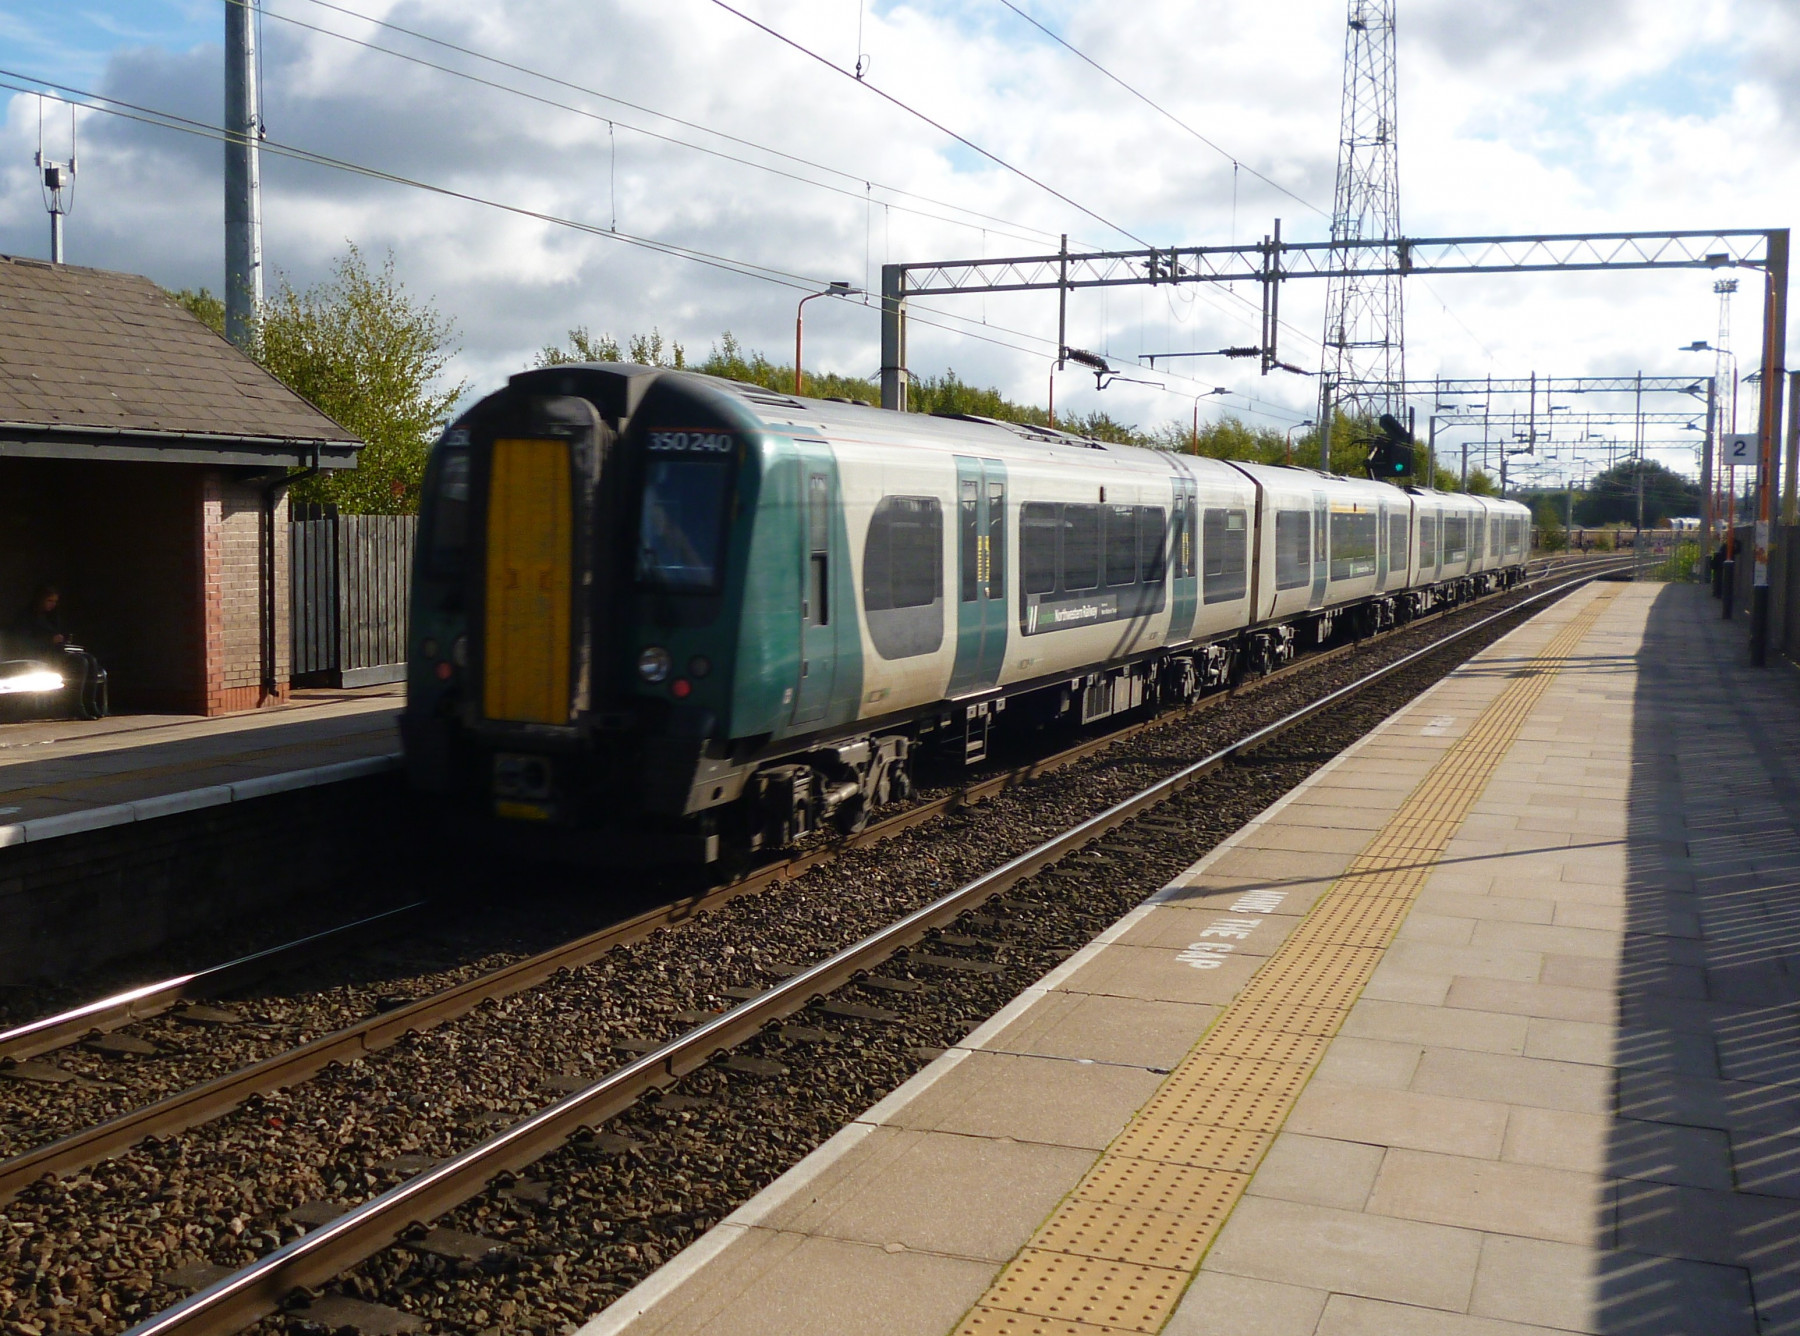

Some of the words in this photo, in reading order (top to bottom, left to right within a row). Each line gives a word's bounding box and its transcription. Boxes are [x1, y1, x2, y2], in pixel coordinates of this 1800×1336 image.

[648, 432, 688, 450] 350
[690, 433, 732, 452] 240
[1734, 440, 1746, 456] 2
[1229, 890, 1289, 913] MIND
[1200, 919, 1263, 939] THE
[1175, 942, 1236, 969] GAP
